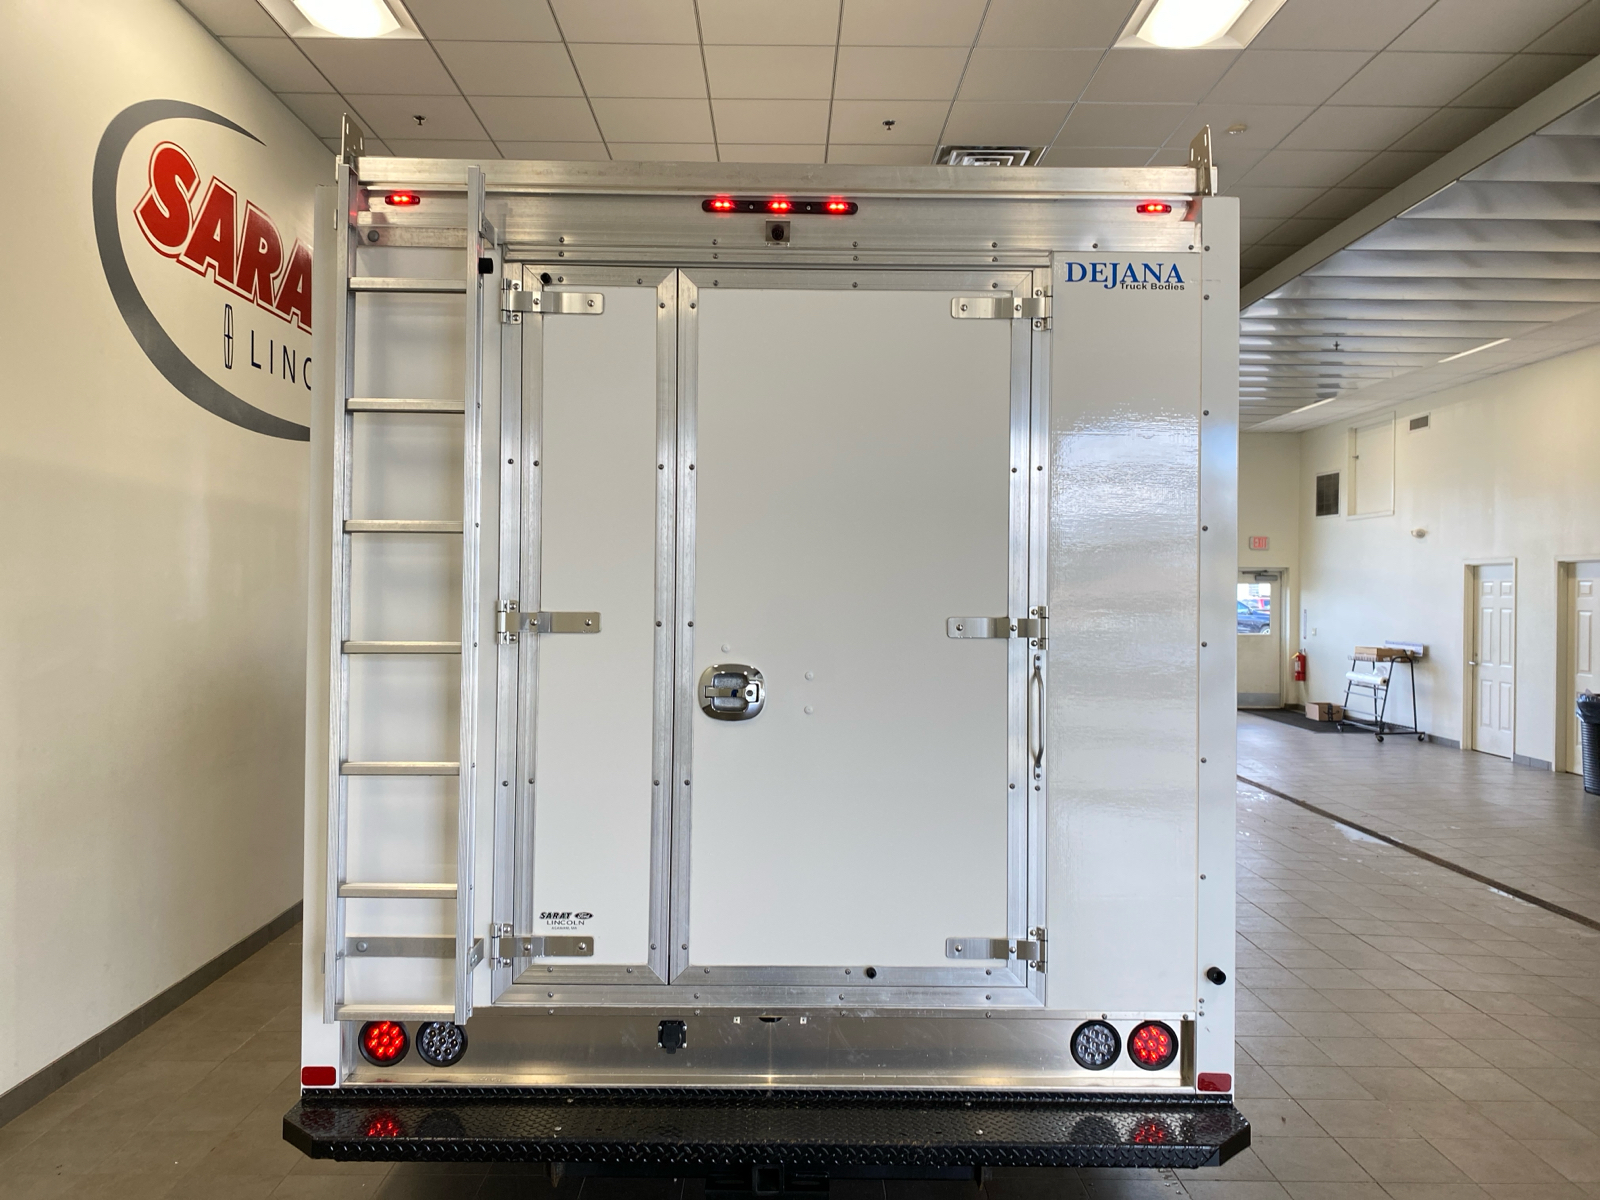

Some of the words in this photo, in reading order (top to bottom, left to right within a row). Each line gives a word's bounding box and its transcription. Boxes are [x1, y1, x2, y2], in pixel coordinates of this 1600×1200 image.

[1065, 262, 1185, 289] DEJANA
[1120, 282, 1147, 290] Truck
[1150, 282, 1185, 290] Bodies
[1253, 536, 1268, 548] EXIT
[539, 911, 572, 919] SARAT
